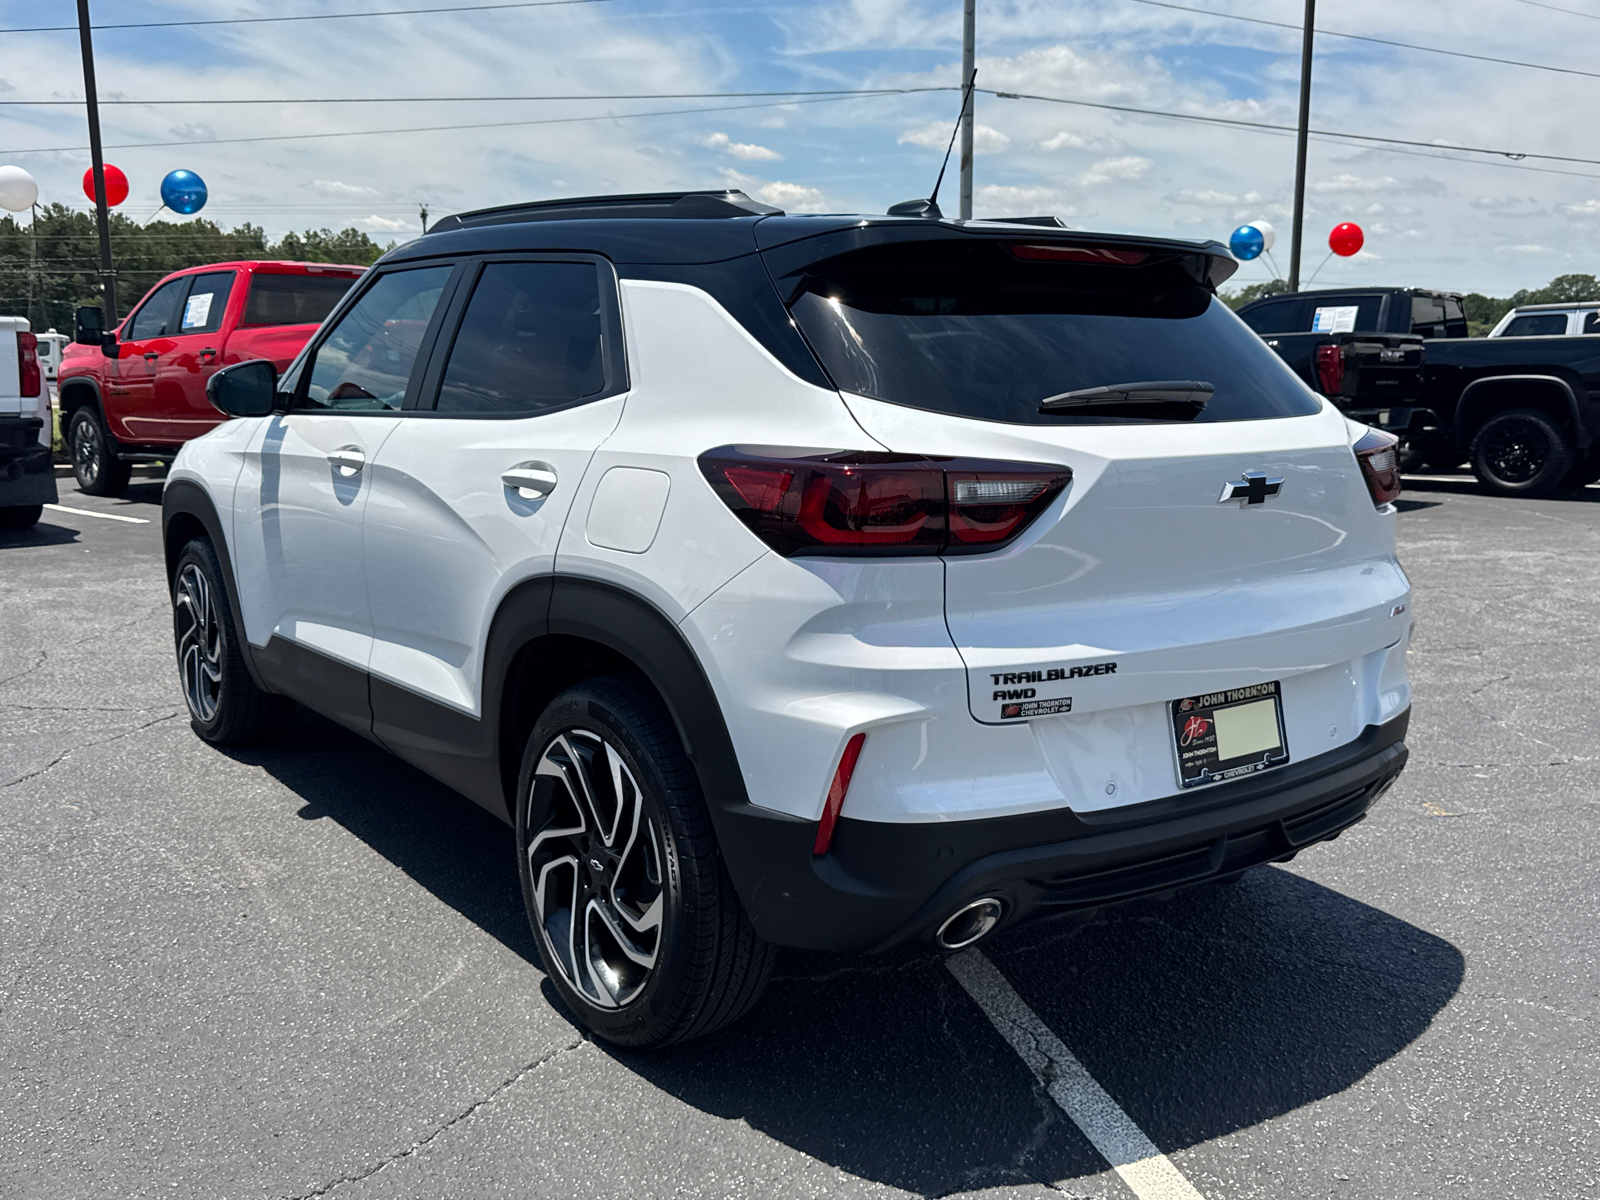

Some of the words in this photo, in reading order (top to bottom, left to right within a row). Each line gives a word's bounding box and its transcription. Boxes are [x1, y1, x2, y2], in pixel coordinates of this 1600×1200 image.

[990, 662, 1118, 685] TRAILBLAZER
[993, 688, 1036, 701] AWD
[1198, 692, 1225, 708] JOHN
[1226, 682, 1275, 702] THORNTON
[1021, 702, 1038, 710] JOHN
[1039, 698, 1071, 709] THORNTON
[1020, 706, 1059, 716] CHEVROLET
[1182, 751, 1194, 759] JOHN
[1193, 746, 1217, 757] THORNTON
[1223, 765, 1255, 778] CHEVROLET
